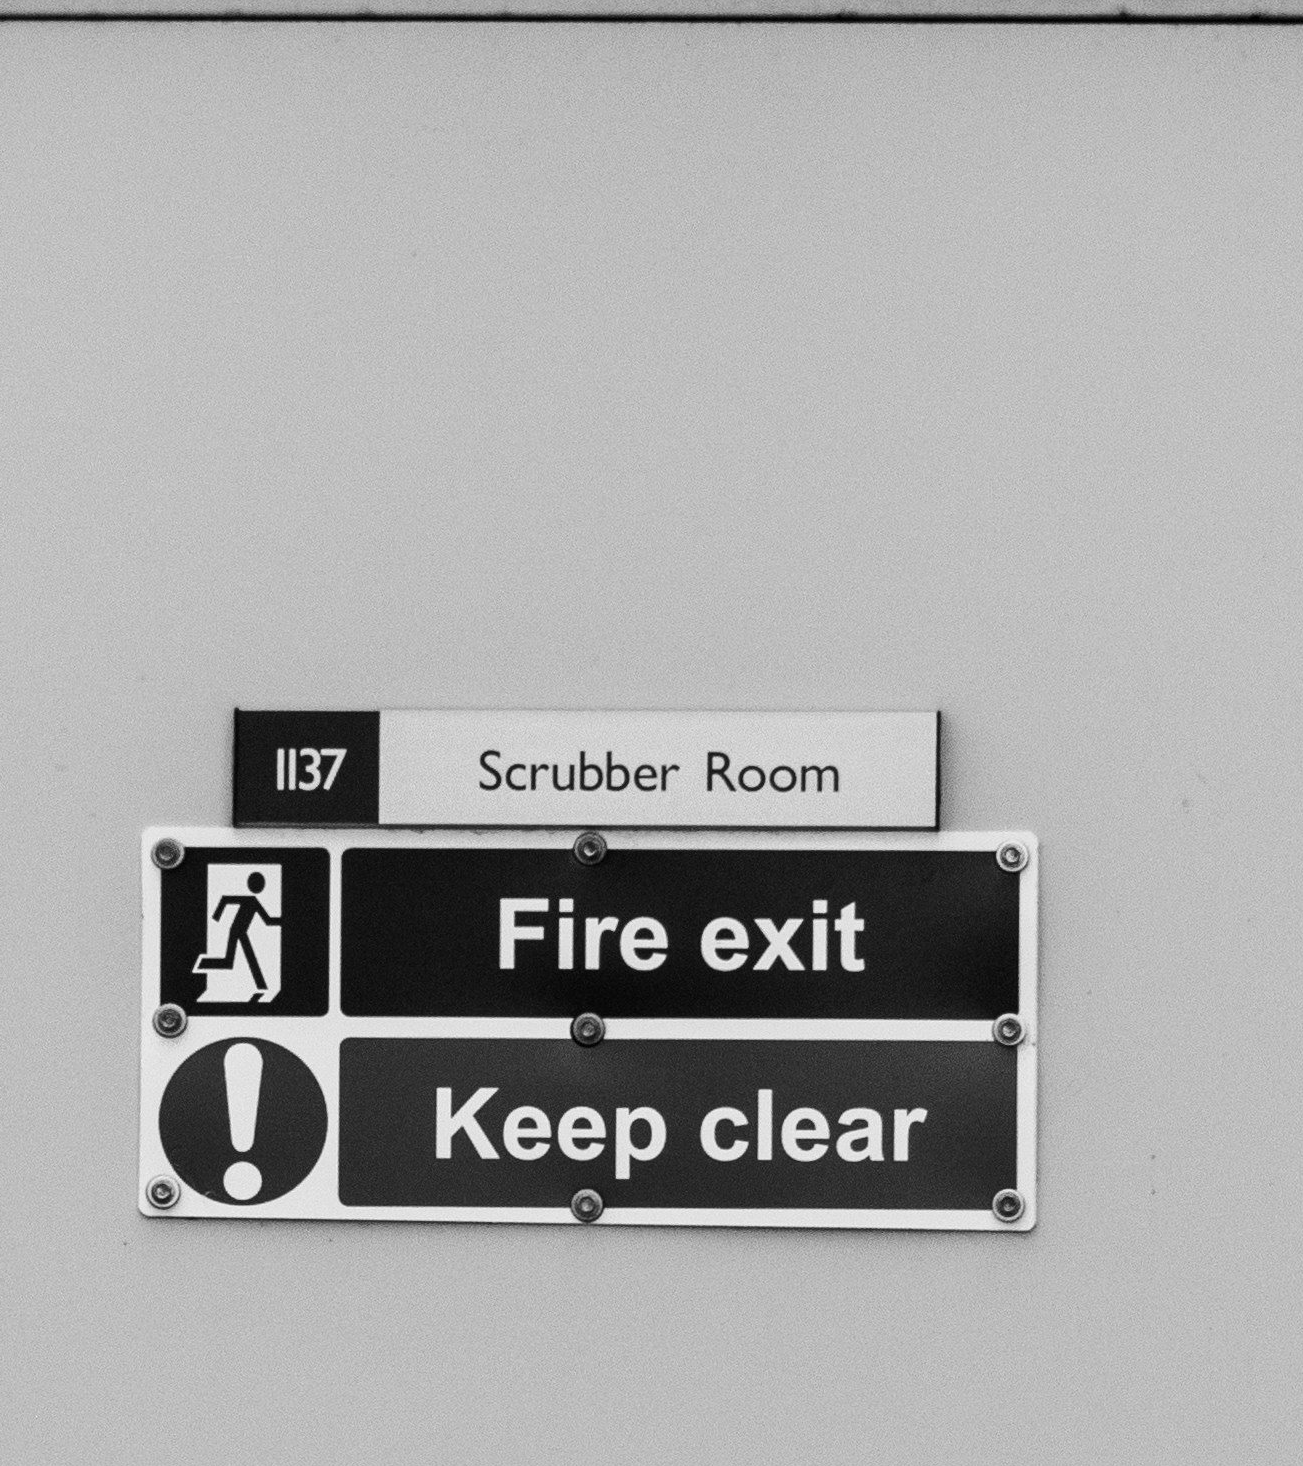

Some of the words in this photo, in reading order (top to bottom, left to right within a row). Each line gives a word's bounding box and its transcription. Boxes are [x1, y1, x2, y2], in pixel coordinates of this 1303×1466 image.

[478, 749, 681, 792] Scrubber
[705, 751, 841, 793] Room
[498, 897, 669, 971] Fire
[700, 899, 866, 972] exit
[435, 1086, 667, 1180] Keep
[699, 1088, 928, 1163] clear
